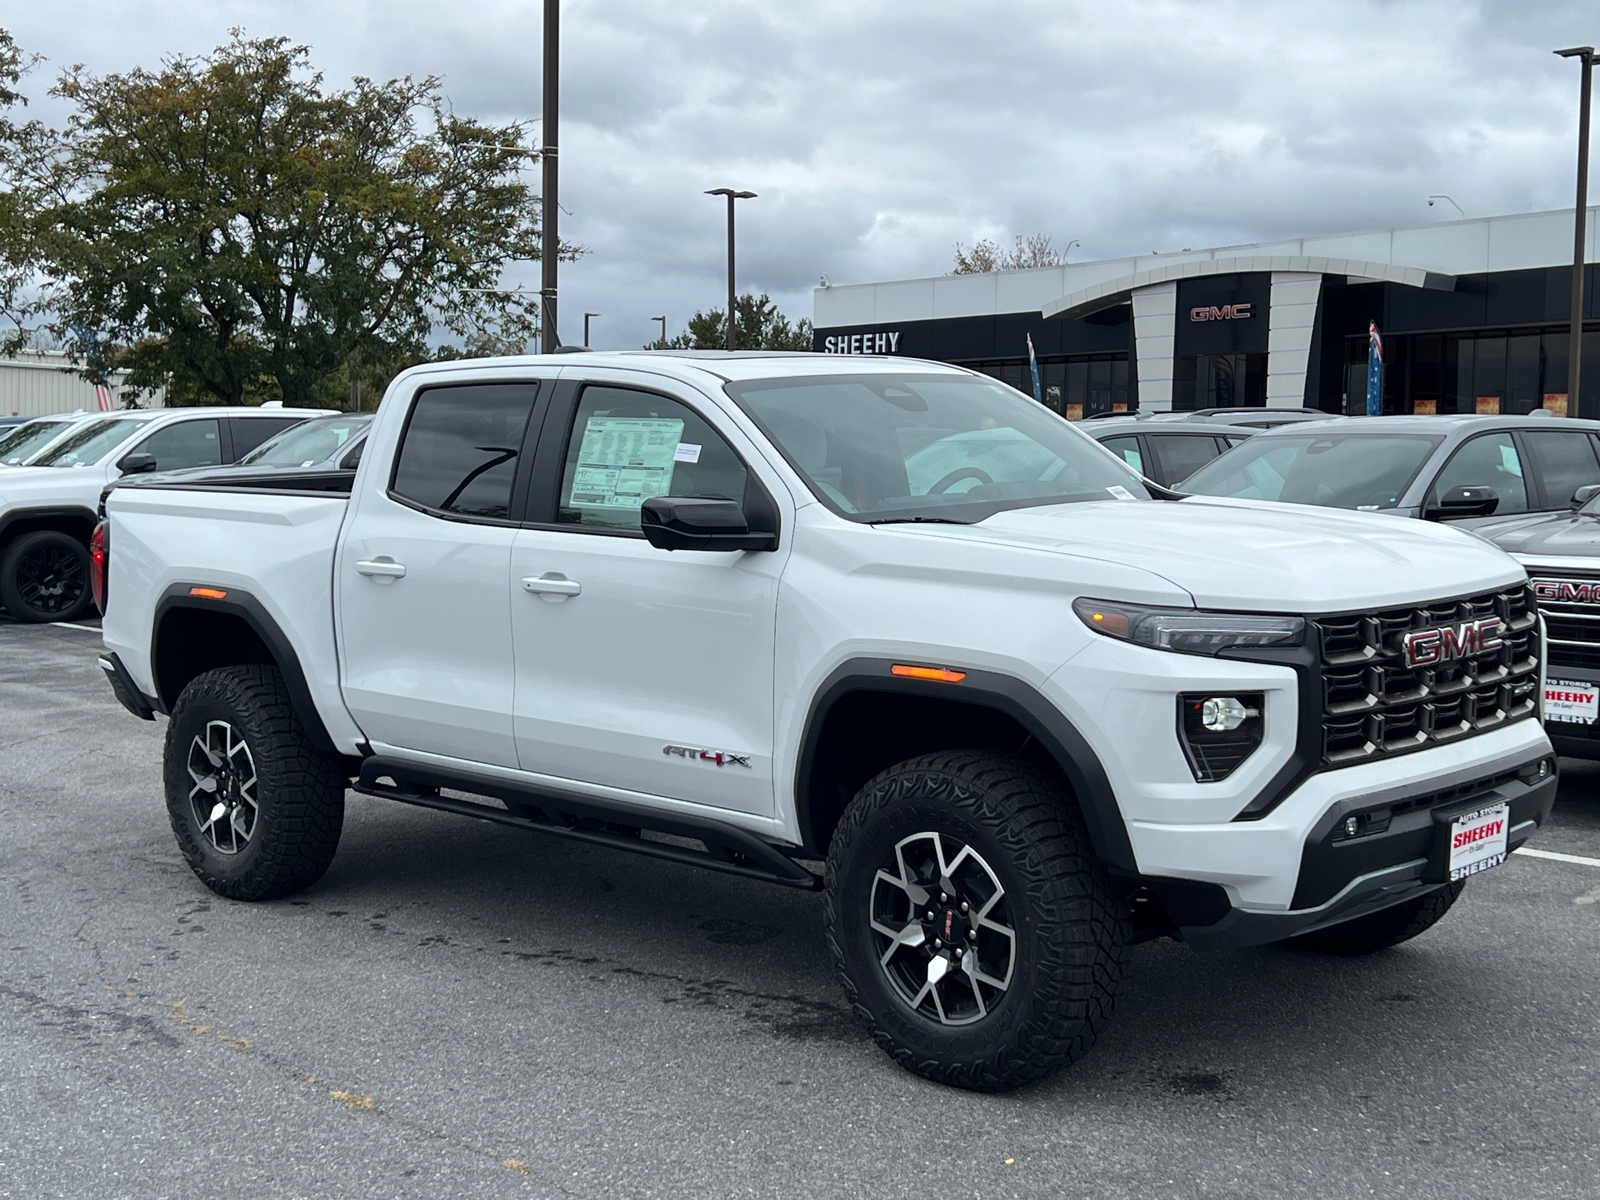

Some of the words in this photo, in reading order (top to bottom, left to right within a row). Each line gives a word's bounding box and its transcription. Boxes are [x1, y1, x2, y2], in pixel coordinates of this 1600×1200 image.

[1190, 304, 1251, 321] GMC
[825, 332, 899, 354] SHEEHY
[1404, 617, 1502, 668] GMC
[1545, 690, 1594, 704] HEEHY
[663, 745, 752, 768] AT4X
[1459, 811, 1478, 824] AUTO
[1453, 819, 1504, 848] SHEEHY
[1450, 852, 1507, 881] SHEEHY
